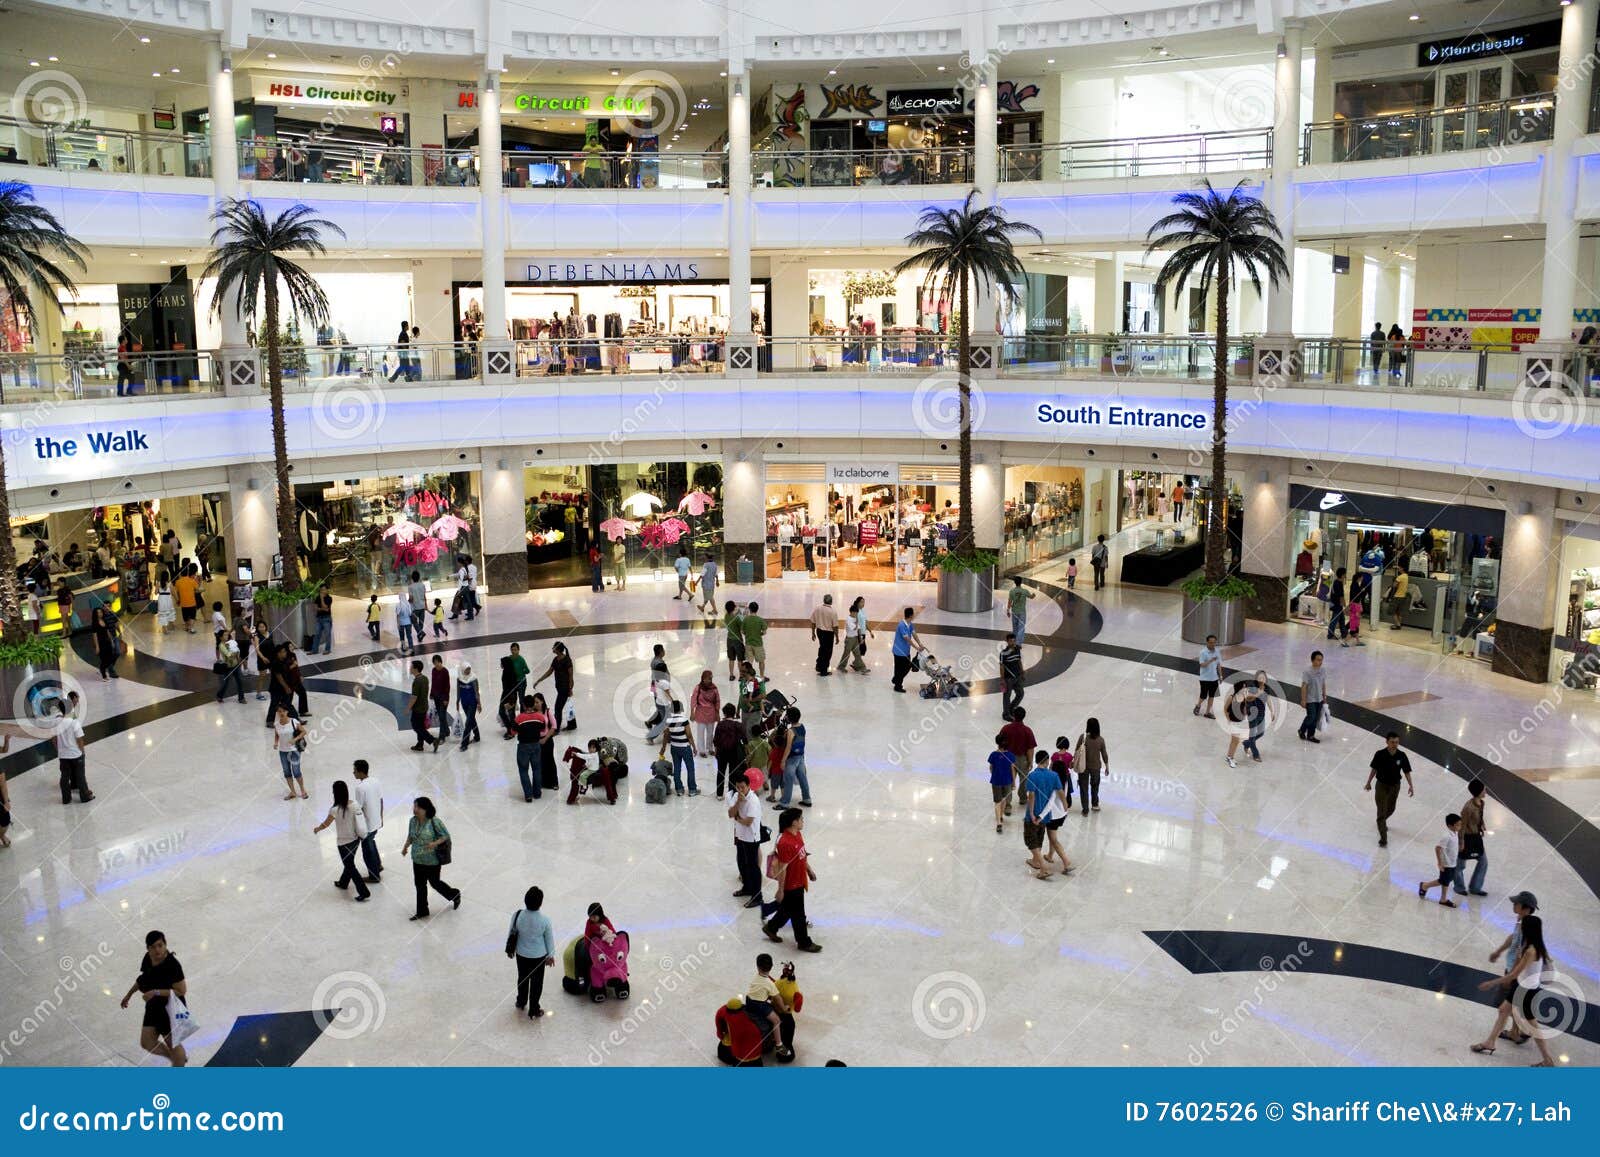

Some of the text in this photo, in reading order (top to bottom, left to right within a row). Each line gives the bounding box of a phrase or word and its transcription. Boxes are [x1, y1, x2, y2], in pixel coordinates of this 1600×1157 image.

[270, 84, 396, 105] HSL Circuit City
[515, 94, 591, 110] Circuit
[603, 96, 645, 113] City
[904, 98, 961, 109] ECHO park
[527, 263, 700, 282] DEBENHAMS
[1037, 404, 1207, 429] South Entrance
[35, 430, 149, 459] the Walk
[833, 467, 889, 478] liz claiborne
[112, 513, 120, 523] 4
[299, 509, 320, 551] G
